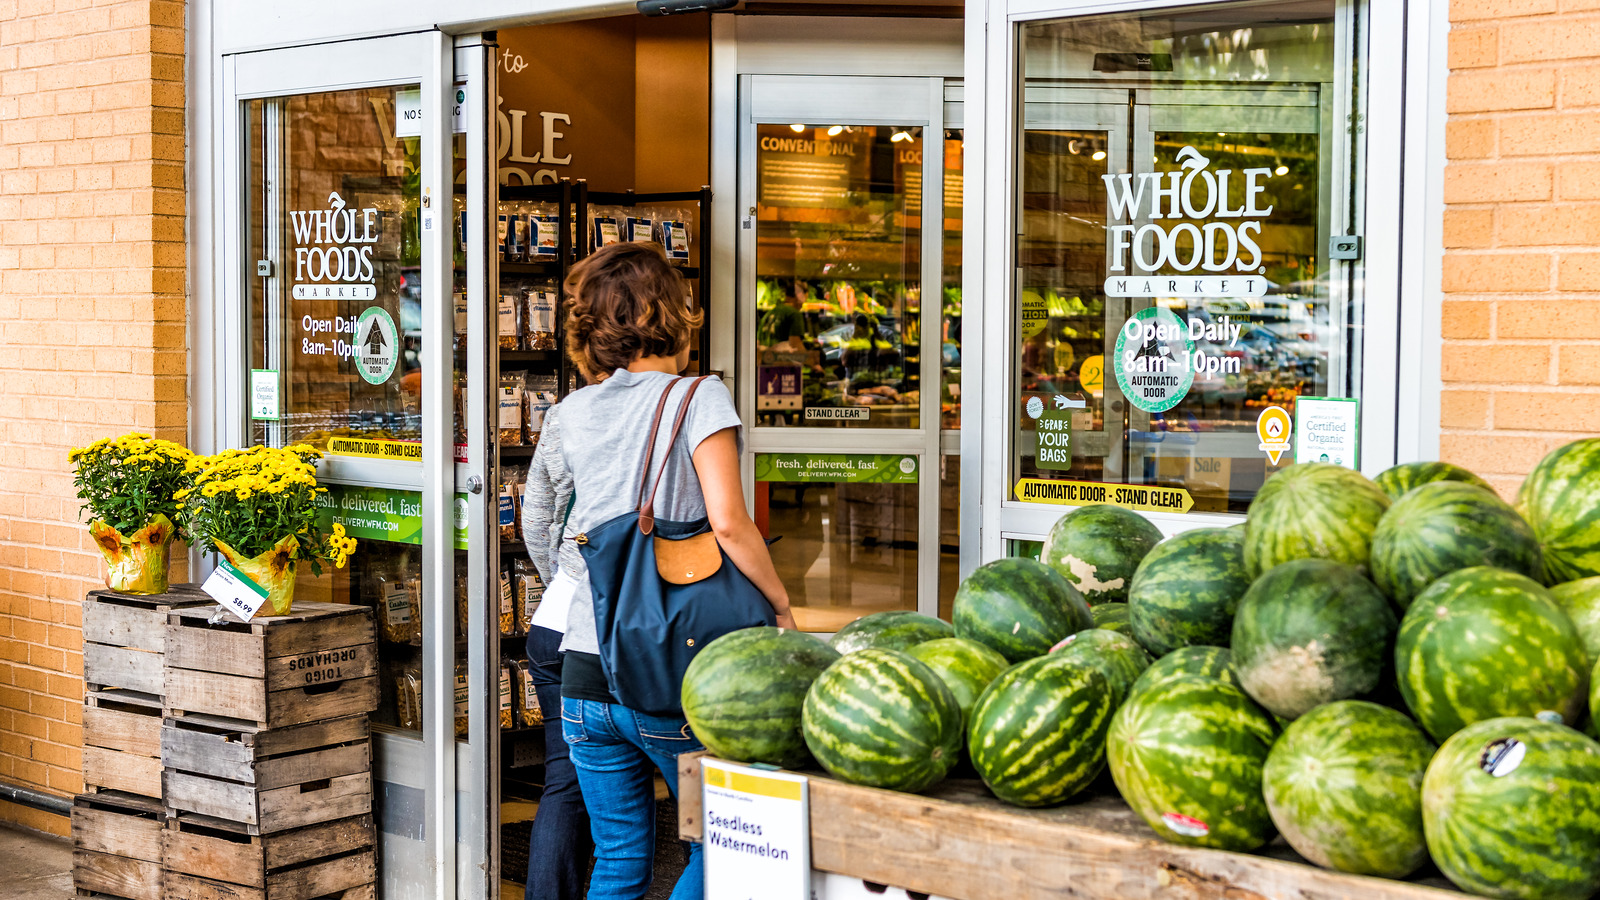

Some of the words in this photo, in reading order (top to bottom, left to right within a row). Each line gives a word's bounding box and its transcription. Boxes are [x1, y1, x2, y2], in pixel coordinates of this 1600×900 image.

[404, 110, 416, 120] NO
[901, 150, 922, 164] LOC
[1101, 146, 1273, 220] WHOLE
[289, 192, 378, 244] WHOLE
[1110, 221, 1262, 272] FOODS
[295, 246, 374, 282] FOODS
[299, 288, 370, 297] MARKET
[1116, 280, 1255, 293] MARKET
[1023, 310, 1047, 319] TION
[302, 315, 332, 337] Open
[335, 316, 363, 340] Daily
[1124, 317, 1181, 348] Open
[1188, 315, 1242, 349] Daily
[362, 357, 389, 366] AUTOMATIC
[369, 366, 382, 374] DOOR
[1131, 375, 1179, 387] AUTOMATIC
[1143, 387, 1166, 398] DOOR
[807, 409, 832, 418] STAND
[835, 409, 860, 418] CLEAR
[1044, 419, 1063, 431] GRAB
[1306, 420, 1346, 432] Certified
[1038, 432, 1069, 447] YOUR
[1308, 432, 1344, 444] Organic
[332, 440, 363, 454] AUTOMATIC
[364, 442, 380, 455] DOOR
[384, 444, 403, 457] STAND
[404, 445, 422, 458] CLEAR
[454, 445, 468, 458] LEAR
[1040, 448, 1067, 463] BAGS
[776, 459, 803, 469] fresh.
[806, 459, 855, 469] delivered.
[858, 460, 879, 470] fast.
[1194, 457, 1221, 473] Sale
[1023, 482, 1077, 500] AUTOMATIC
[1079, 486, 1106, 502] DOOR
[1115, 488, 1148, 505] STAND
[1150, 491, 1183, 508] CLEAR
[313, 491, 338, 509] esh.
[341, 493, 397, 515] delivered.
[221, 561, 234, 572] New
[232, 597, 253, 613] $8.99
[289, 649, 356, 671] ORCHARDS
[305, 667, 343, 683] TOIGO
[708, 810, 763, 836] Seedless
[708, 830, 789, 860] Watermelon
